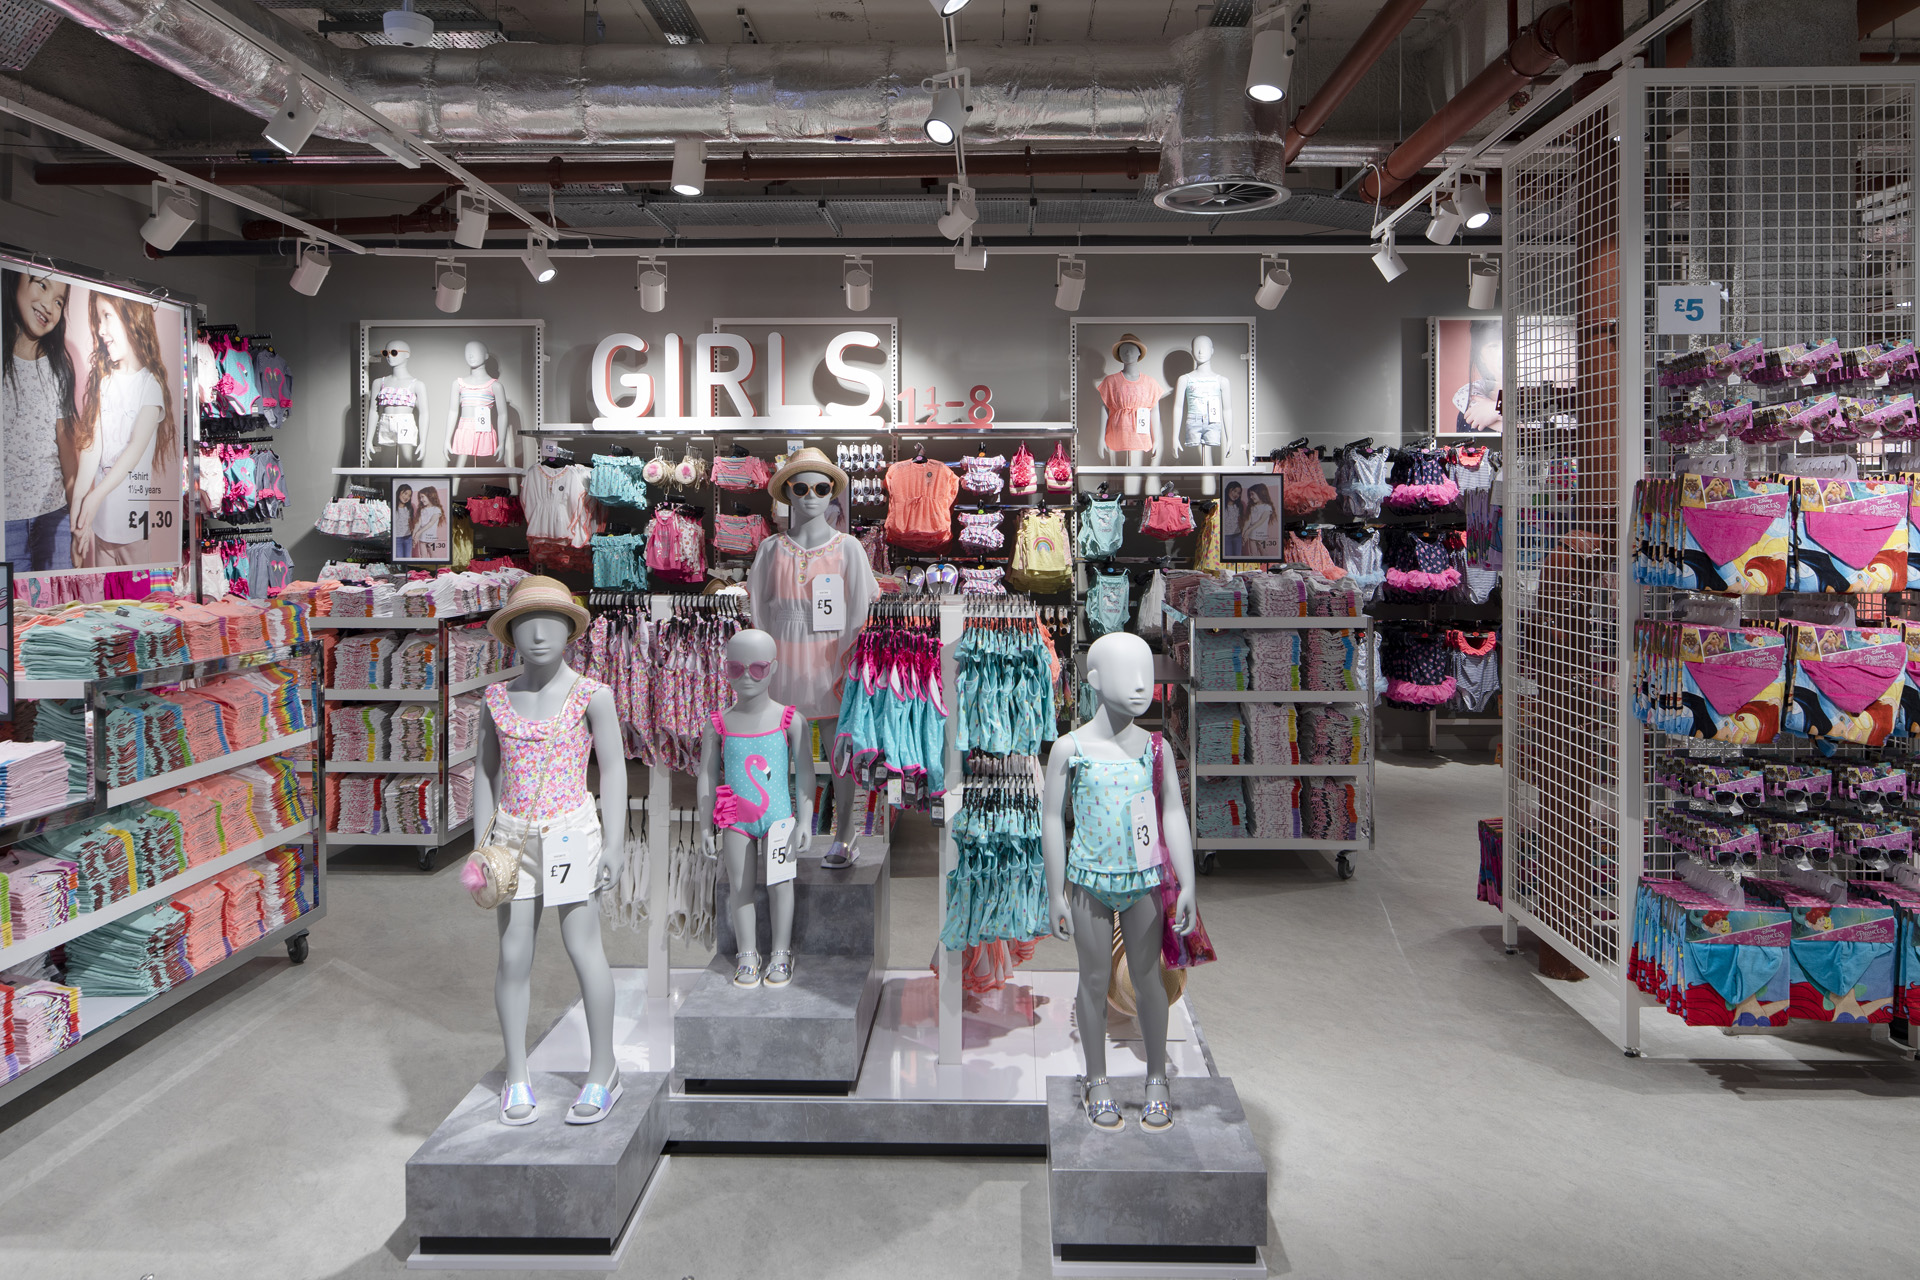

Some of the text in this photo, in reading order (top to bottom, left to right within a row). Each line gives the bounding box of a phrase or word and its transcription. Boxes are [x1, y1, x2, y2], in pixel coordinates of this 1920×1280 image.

[1674, 298, 1704, 322] £5
[592, 331, 885, 421] GIRLS
[545, 445, 554, 453] £5
[128, 471, 148, 481] T-shirt
[144, 486, 162, 496] years
[128, 510, 172, 540] £1.30
[817, 599, 832, 616] £5
[1136, 825, 1150, 846] £3
[771, 846, 786, 864] £5
[550, 863, 571, 884] £7
